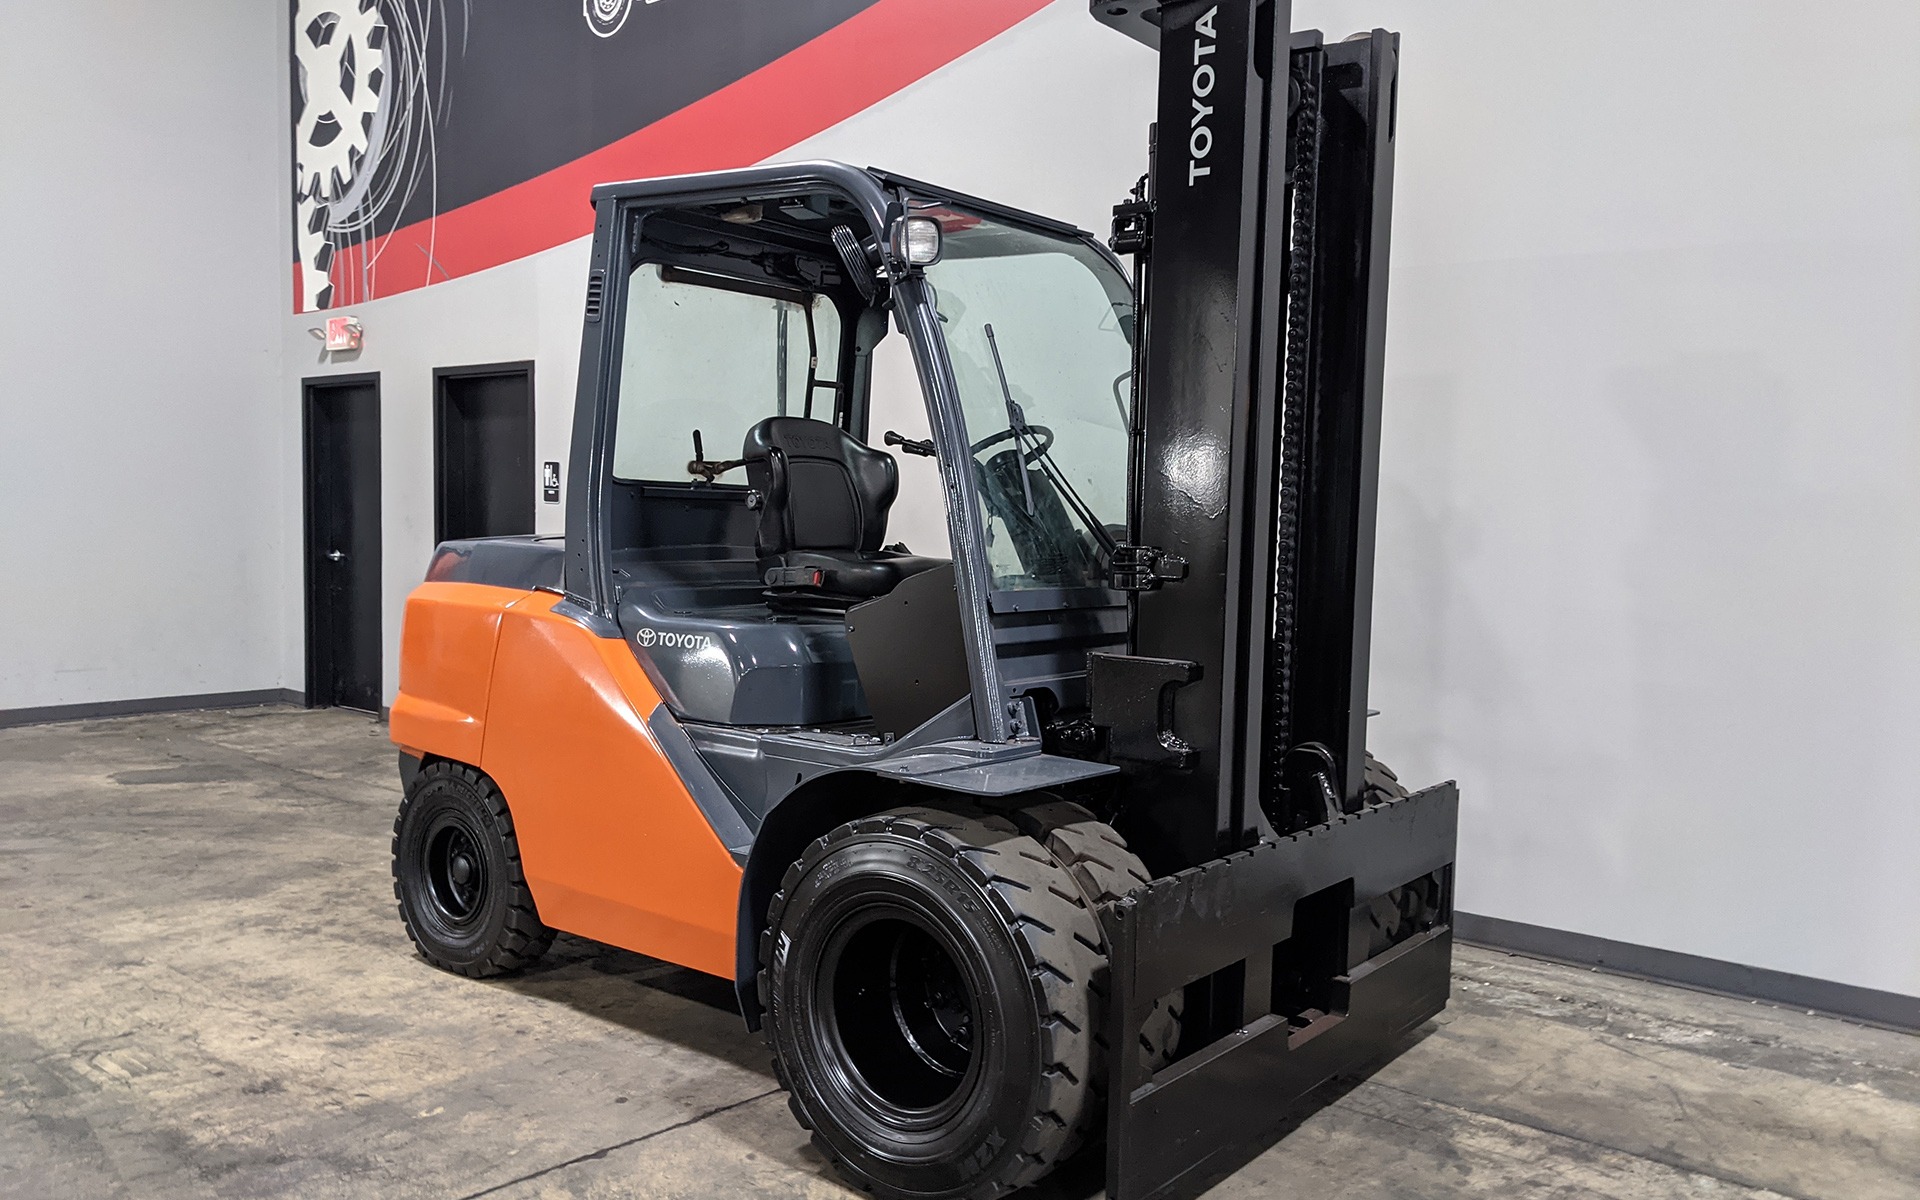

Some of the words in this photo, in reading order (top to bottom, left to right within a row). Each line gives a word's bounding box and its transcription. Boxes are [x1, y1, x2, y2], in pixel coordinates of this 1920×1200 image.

[1188, 5, 1218, 187] TOYOTA
[784, 433, 833, 451] TOYOTA
[657, 631, 712, 650] TOYOTA
